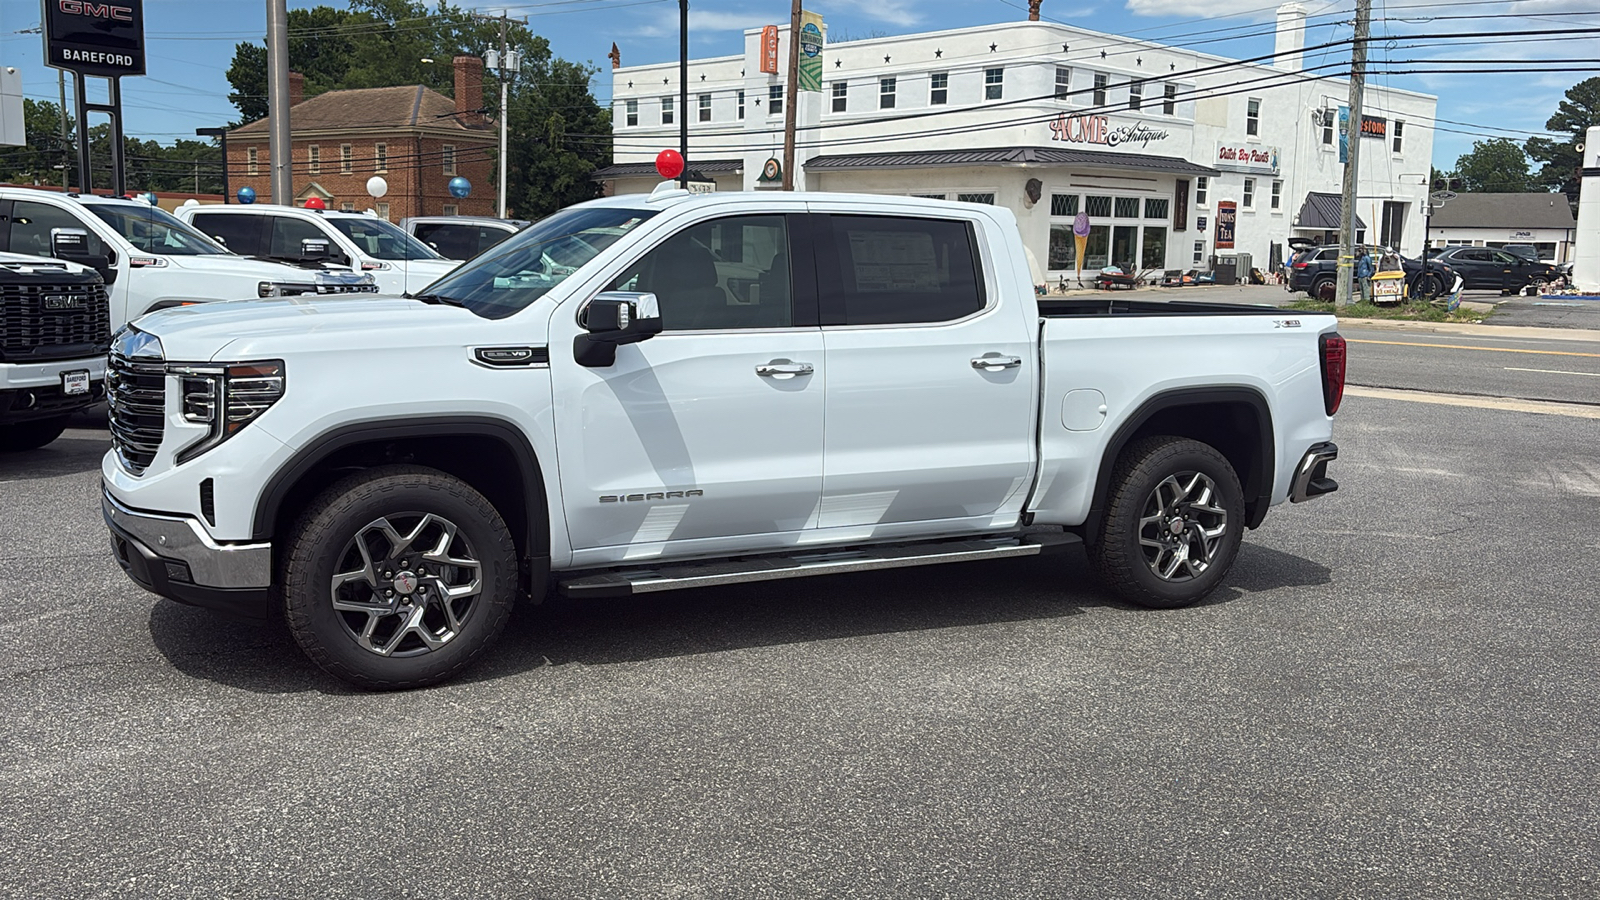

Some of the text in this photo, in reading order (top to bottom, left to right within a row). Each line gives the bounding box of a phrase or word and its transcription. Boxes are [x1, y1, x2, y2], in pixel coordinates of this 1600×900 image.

[59, 0, 133, 21] GMC
[63, 49, 133, 66] BAREFORD
[768, 28, 776, 70] ACME
[1049, 112, 1109, 145] ACME
[1219, 146, 1269, 164] Dutch Boy Paints
[1219, 227, 1232, 239] TEA
[45, 295, 88, 309] GMC
[599, 489, 704, 503] SIERRA
